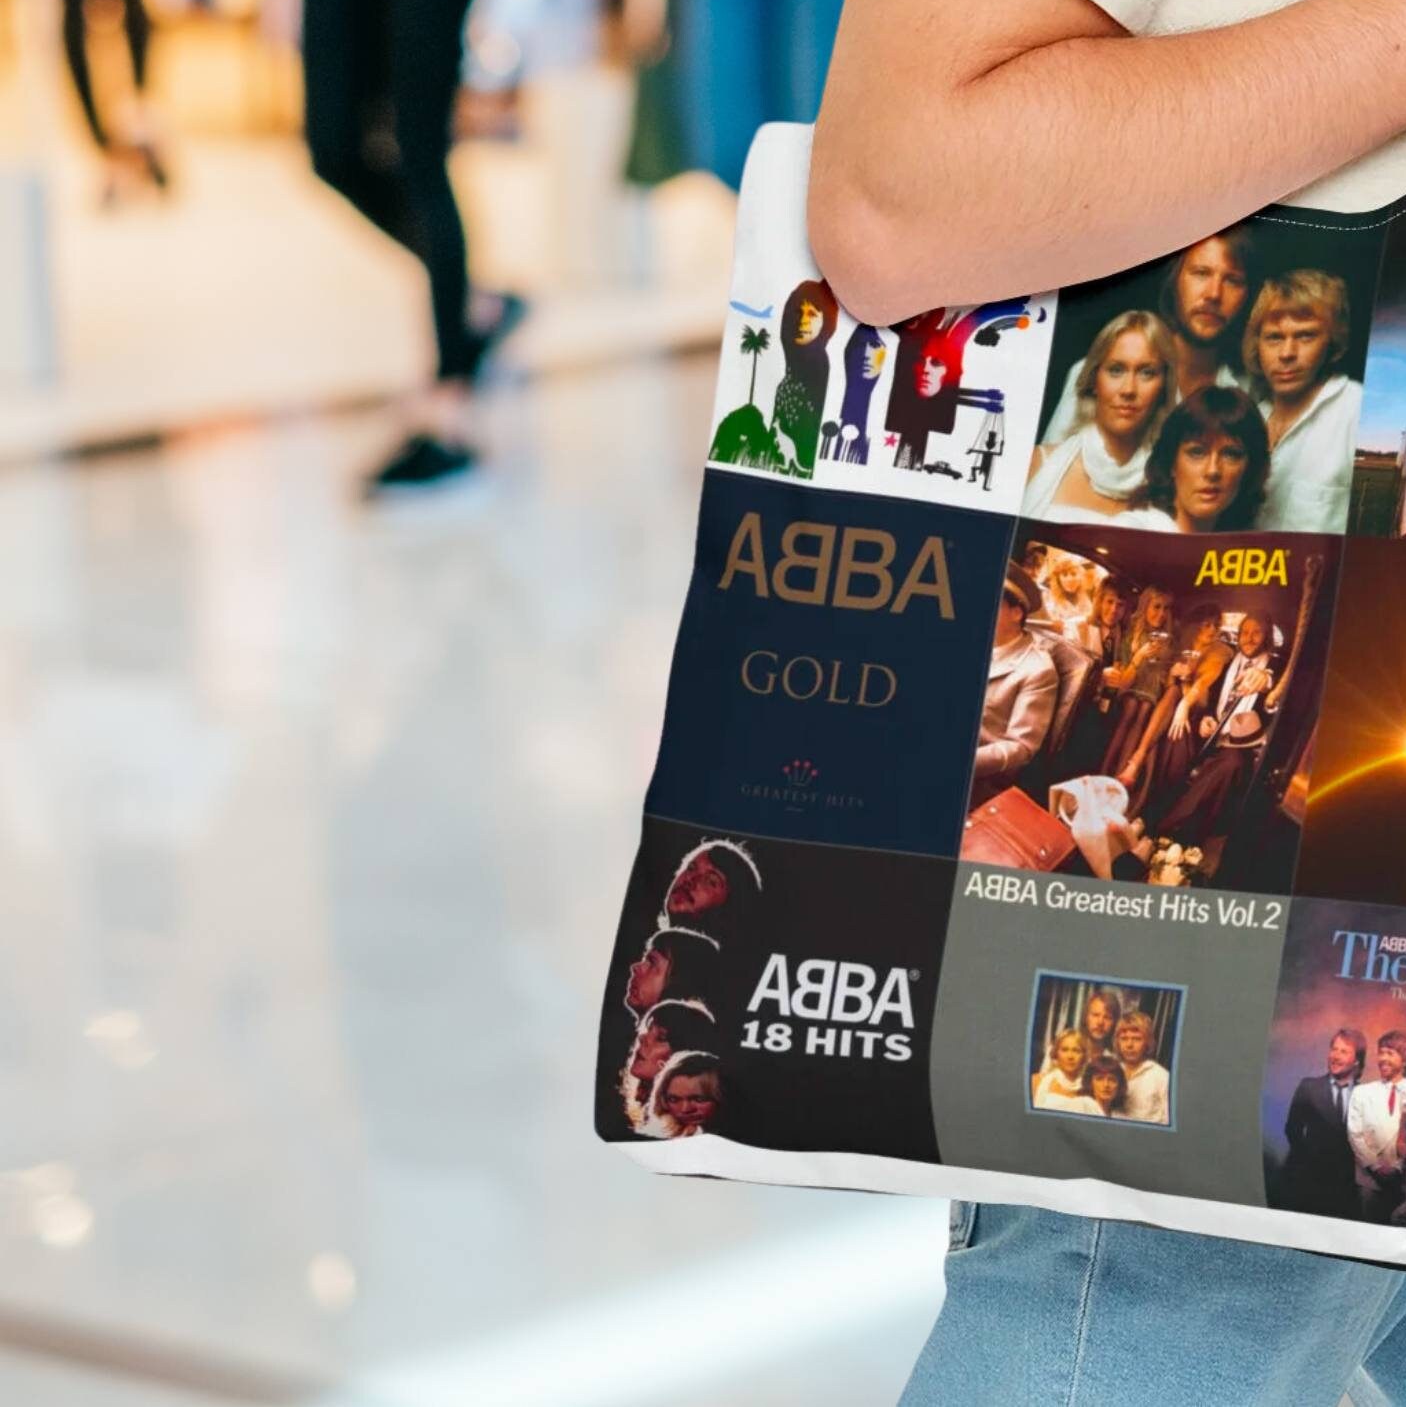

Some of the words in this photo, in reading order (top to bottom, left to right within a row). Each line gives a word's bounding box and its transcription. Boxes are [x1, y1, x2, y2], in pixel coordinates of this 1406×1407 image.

[717, 511, 955, 620] ABBA
[1195, 548, 1288, 586] ABBA
[741, 650, 897, 708] GOLD
[964, 872, 1038, 906] ABBA
[1045, 882, 1153, 919] Greatest
[1159, 895, 1211, 924] Hits
[747, 953, 914, 1028] ABBA
[740, 1021, 792, 1053] 18
[805, 1026, 913, 1062] HITS
